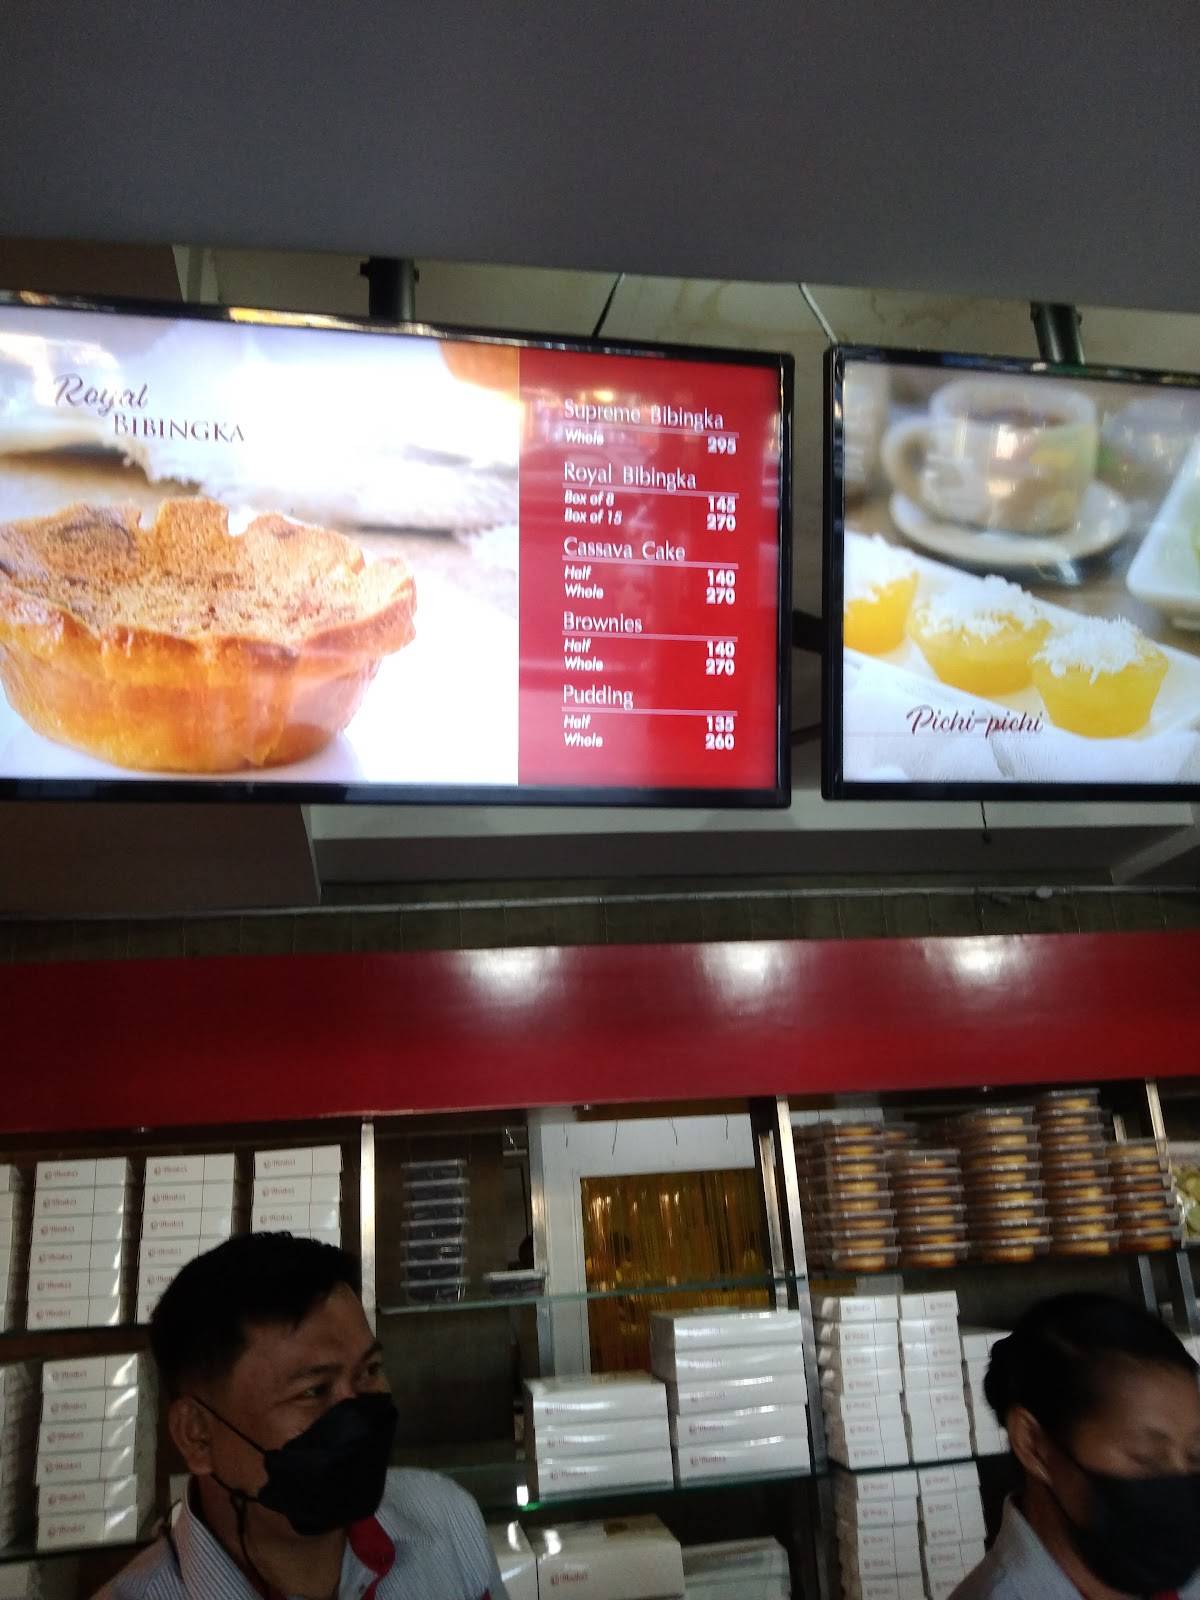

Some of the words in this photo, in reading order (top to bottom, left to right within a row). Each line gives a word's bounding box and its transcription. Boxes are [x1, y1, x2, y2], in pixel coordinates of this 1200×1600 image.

[54, 373, 148, 416] Royal
[565, 398, 640, 426] Supreme
[651, 404, 724, 432] Bibingka
[114, 413, 245, 442] BIBINGKA
[565, 429, 604, 447] Whole
[707, 436, 737, 455] 295
[564, 461, 612, 487] Royal
[623, 465, 697, 493] Bibingka
[564, 489, 587, 505] Box
[590, 490, 604, 506] of
[707, 495, 736, 513] 145
[564, 507, 587, 524] Box
[590, 508, 604, 525] of
[706, 513, 736, 532] 270
[563, 536, 633, 559] Cassava
[642, 540, 686, 560] Cake
[564, 564, 592, 581] Half
[707, 568, 735, 586] 140
[564, 583, 604, 600] Whole
[706, 586, 735, 605] 270
[563, 611, 643, 633] Brownies
[564, 637, 592, 654] Half
[706, 640, 735, 658] 140
[564, 655, 604, 672] Whole
[705, 658, 735, 676] 270
[563, 684, 634, 710] Pudding
[564, 714, 592, 729] Half
[706, 716, 734, 733] 135
[906, 704, 1044, 739] Pichi-pichi
[564, 732, 604, 748] Whole
[705, 732, 735, 750] 260
